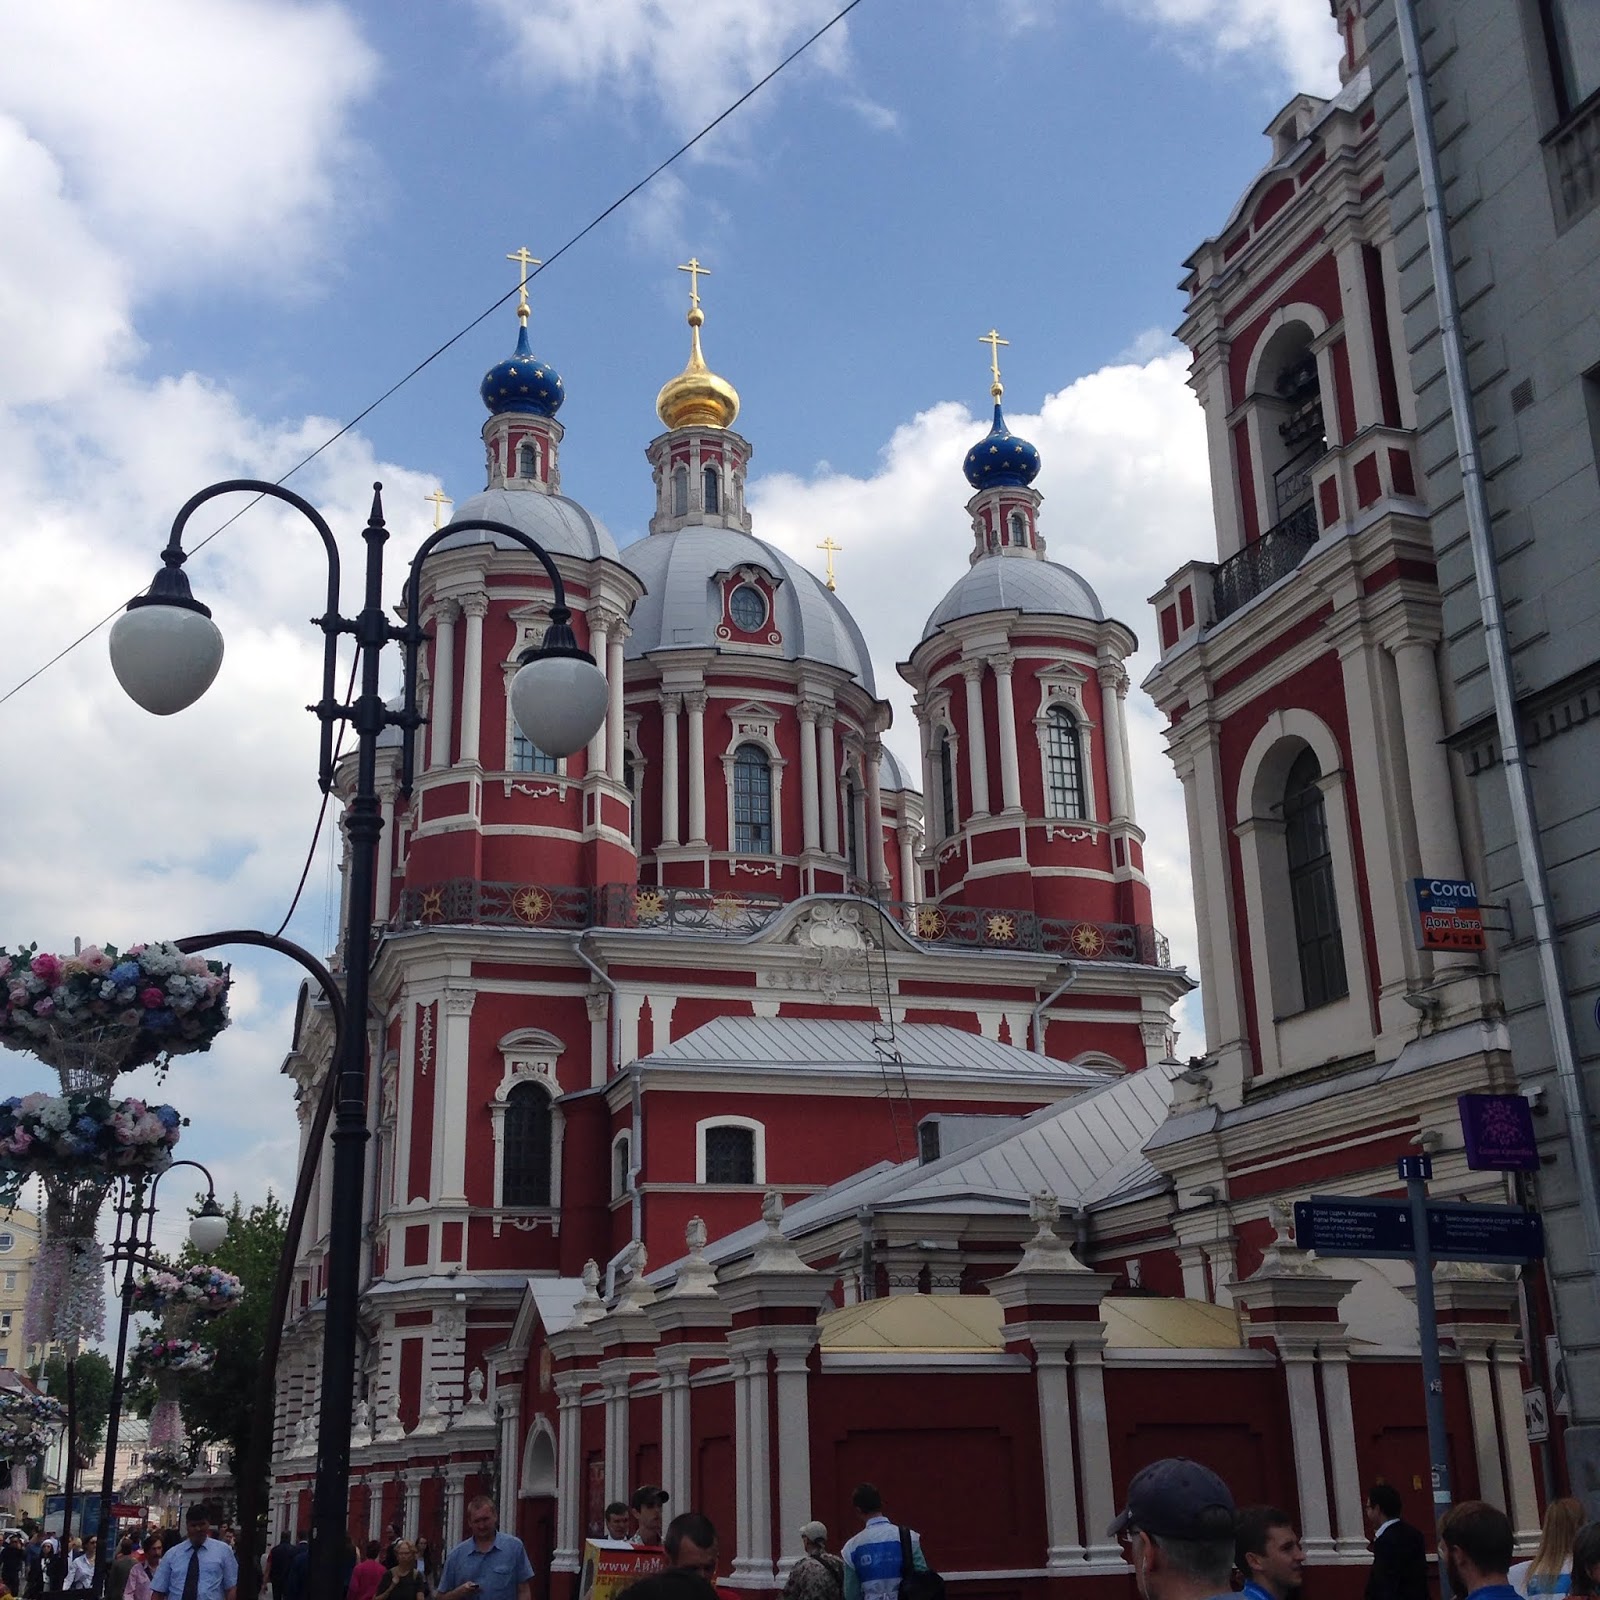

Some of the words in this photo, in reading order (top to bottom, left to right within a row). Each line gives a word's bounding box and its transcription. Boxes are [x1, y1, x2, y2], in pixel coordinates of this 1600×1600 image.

[1430, 881, 1477, 897] Coral
[1425, 915, 1451, 930] Дом
[1453, 917, 1482, 931] Быта
